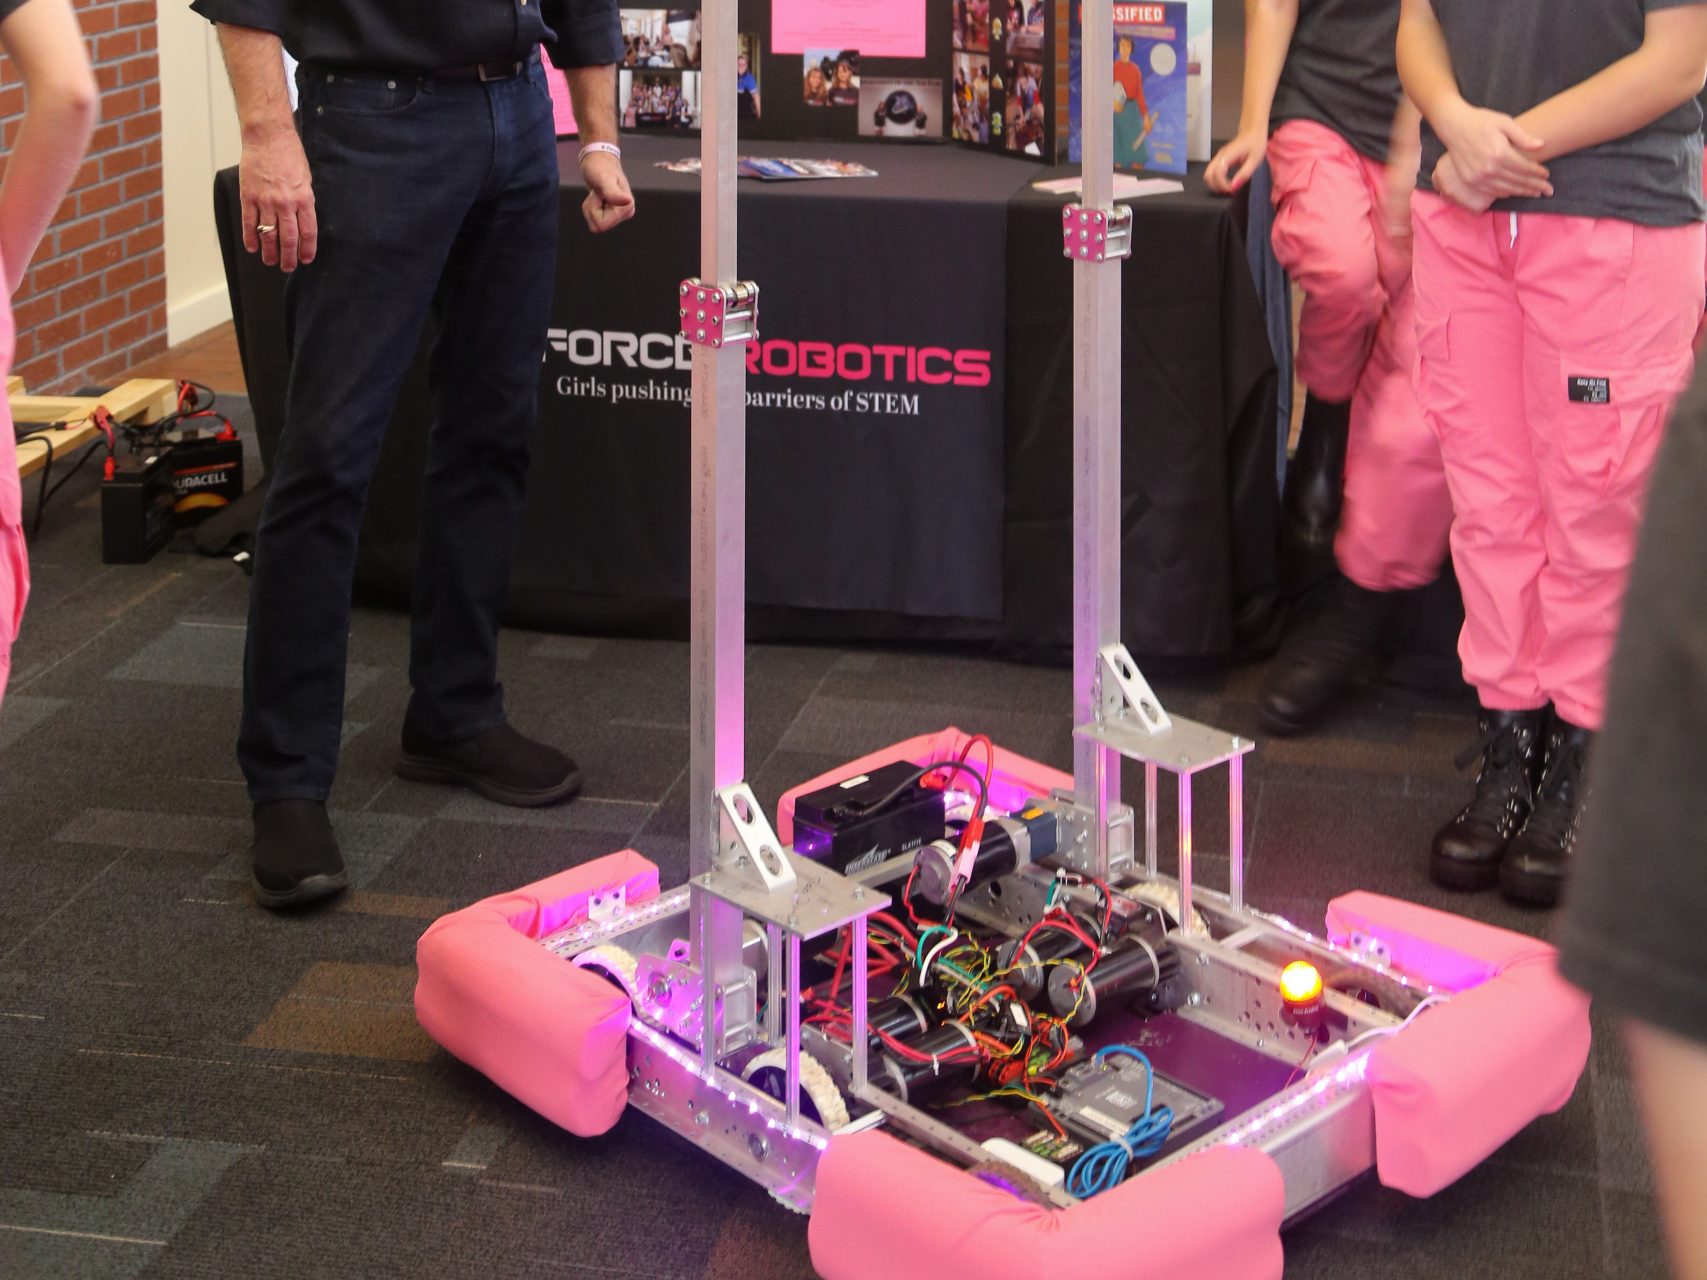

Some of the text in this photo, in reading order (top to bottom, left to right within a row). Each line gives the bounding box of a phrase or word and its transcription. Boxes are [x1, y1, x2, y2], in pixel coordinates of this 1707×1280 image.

[556, 375, 607, 398] Girls
[611, 379, 692, 408] pushing
[830, 389, 855, 411] of
[856, 391, 920, 415] STEM
